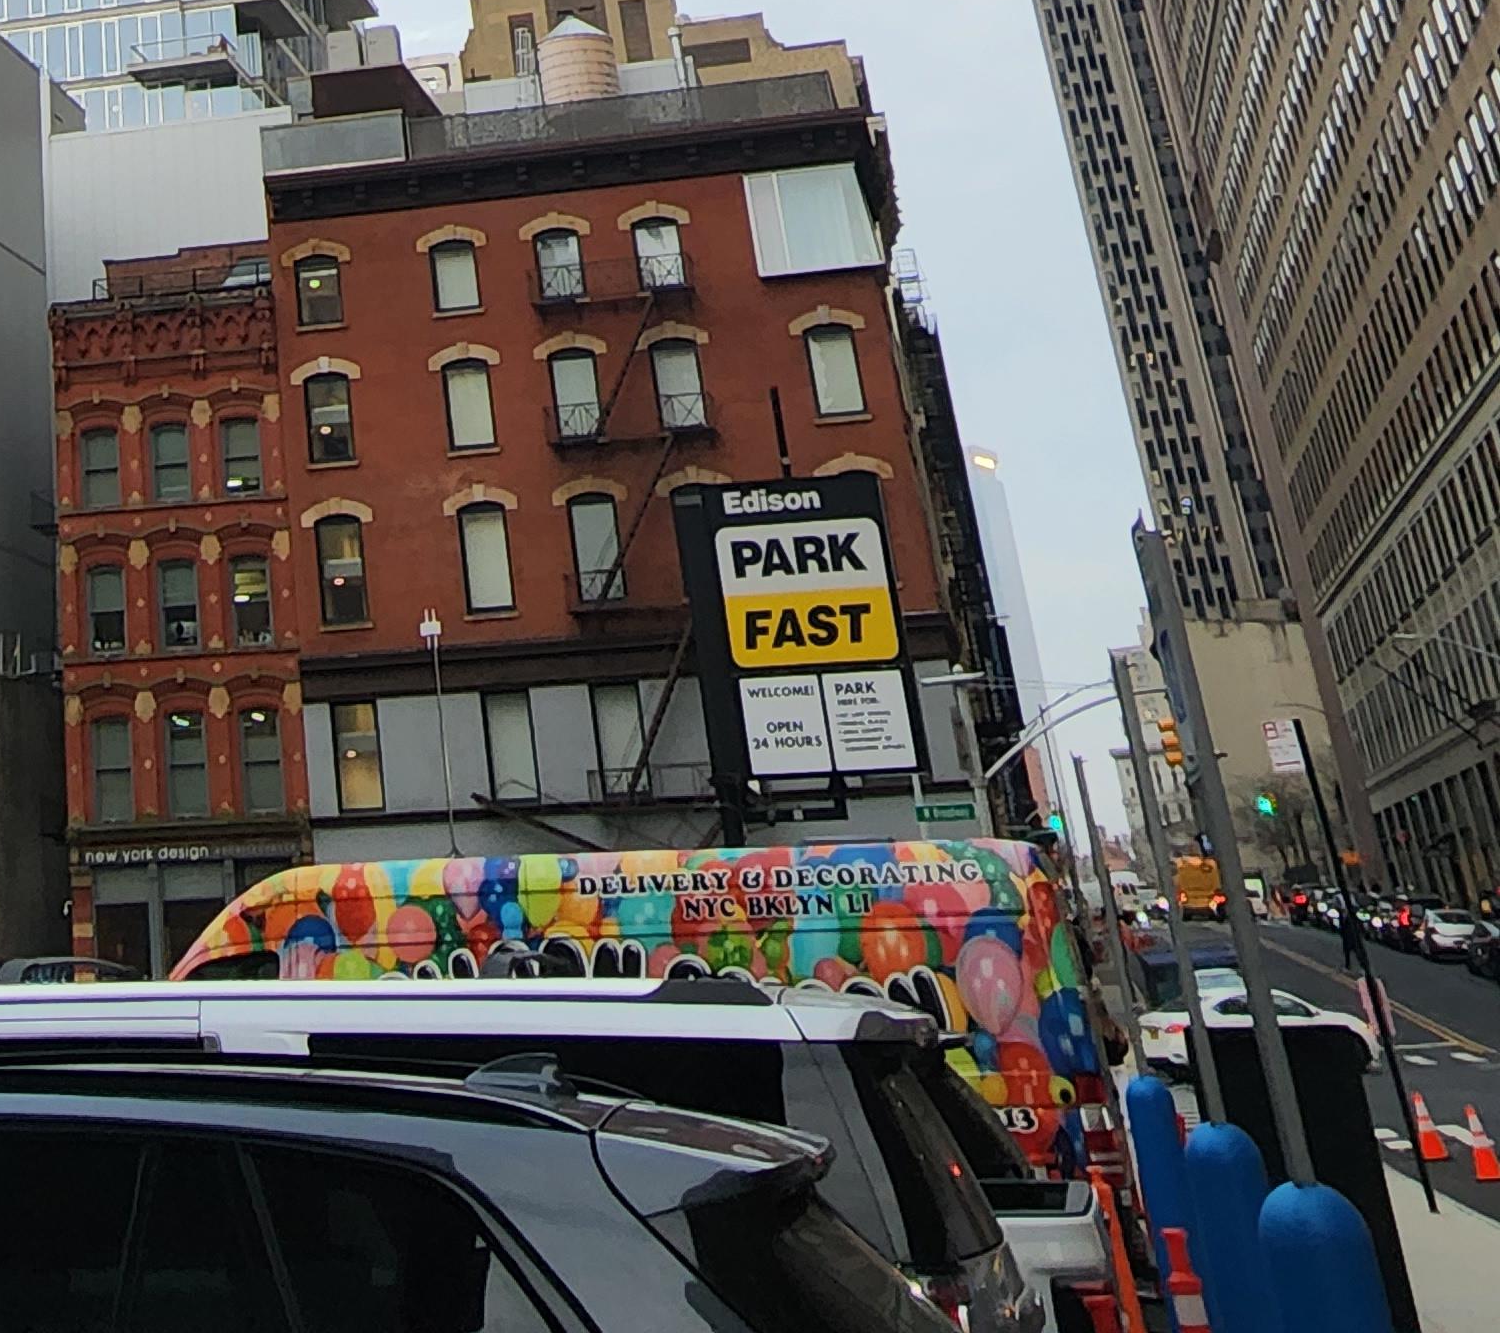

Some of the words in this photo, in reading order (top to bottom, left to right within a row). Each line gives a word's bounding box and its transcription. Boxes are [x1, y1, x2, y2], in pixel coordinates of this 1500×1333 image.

[722, 489, 821, 515] Edison
[730, 532, 868, 579] PARK
[745, 602, 871, 650] FAST
[747, 685, 815, 698] WELCOME!
[835, 681, 876, 695] PARK
[766, 721, 804, 734] OPEN
[752, 737, 769, 750] 24
[774, 735, 822, 749] HOURS
[85, 850, 118, 863] new
[122, 848, 154, 864] york
[157, 845, 210, 861] design
[578, 872, 728, 896] DELIVERY
[739, 871, 763, 890] &
[775, 863, 981, 889] DECORATING
[683, 897, 738, 920] NYC
[748, 893, 836, 917] BKLYN
[848, 892, 873, 914] LI
